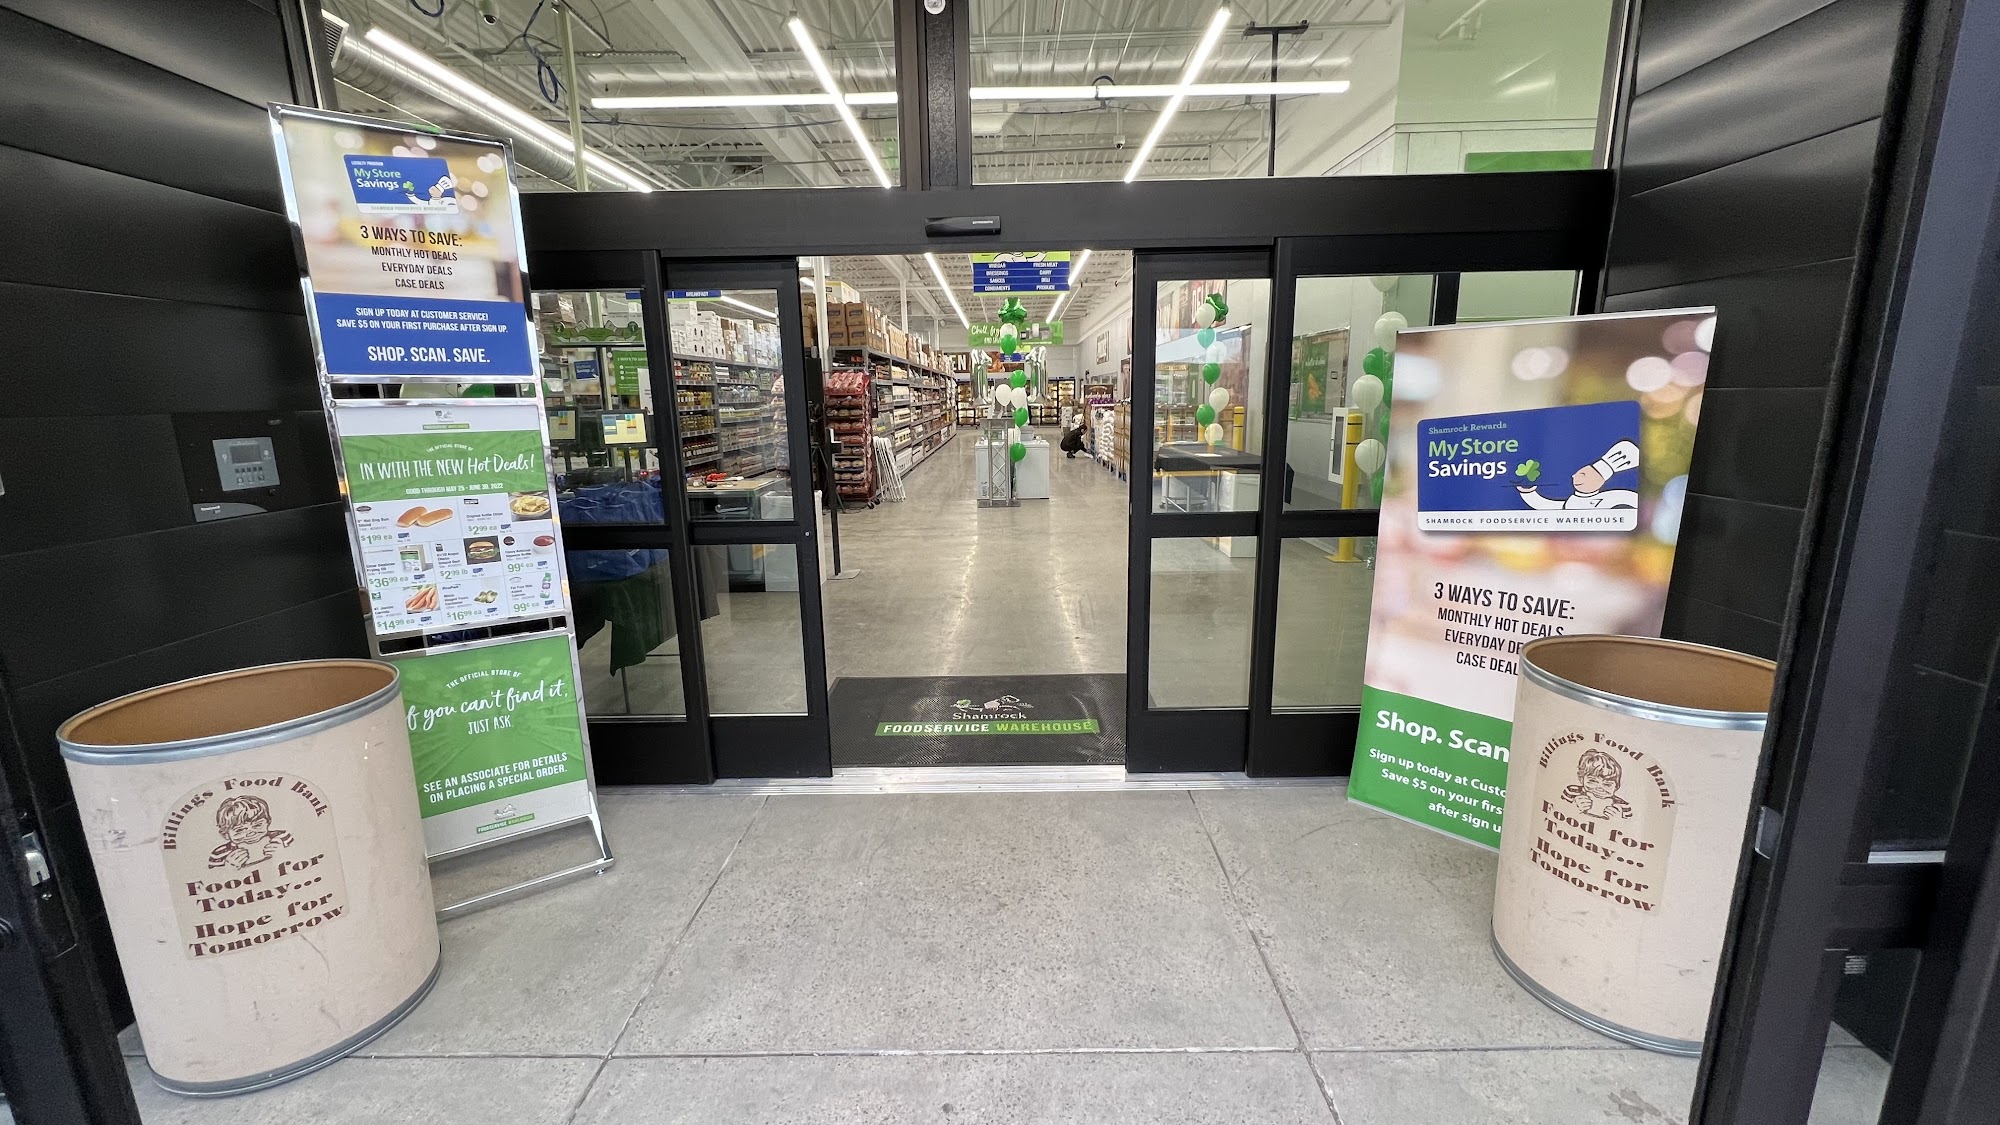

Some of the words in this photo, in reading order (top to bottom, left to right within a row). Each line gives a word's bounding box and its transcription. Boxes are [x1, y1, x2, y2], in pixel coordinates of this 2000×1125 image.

[354, 168, 371, 179] My
[372, 169, 401, 178] Store
[356, 179, 399, 190] Savings
[360, 226, 368, 238] 3
[372, 226, 407, 242] WAYS
[409, 230, 425, 244] TO
[429, 232, 462, 246] SAVE:
[371, 246, 411, 258] MONTHLY
[414, 249, 430, 259] HOT
[432, 251, 458, 261] DEALS
[382, 262, 425, 274] EVERYDAY
[427, 266, 453, 276] DEALS
[395, 278, 417, 288] CASE
[419, 280, 445, 290] DEALS
[336, 319, 356, 328] SAVE
[358, 320, 368, 328] $5
[370, 320, 380, 328] ON
[381, 321, 400, 330] YOUR
[402, 322, 421, 330] FIRST
[423, 322, 459, 331] PURCHASE
[460, 323, 481, 332] AFTER
[482, 324, 497, 332] SIGN
[356, 308, 373, 316] SIGN
[386, 309, 408, 318] TODAY
[411, 310, 419, 318] AT
[421, 311, 458, 320] CUSTOMER
[459, 312, 488, 320] SERVICE!
[367, 346, 408, 361] SHOP.
[410, 347, 450, 362] SCAN.
[453, 348, 490, 362] SAVE.
[1428, 424, 1468, 435] Shamrock
[1470, 421, 1507, 431] Rewards
[1428, 440, 1458, 460] My
[1461, 437, 1518, 455] Store
[360, 463, 374, 480] IN
[377, 461, 410, 479] WITH
[413, 460, 434, 477] THE
[436, 459, 464, 476] NEW
[468, 457, 490, 474] Hot
[494, 454, 534, 472] Deals!
[1428, 459, 1507, 480] Savings
[1434, 582, 1444, 599] 3
[1449, 583, 1492, 607] WAYS
[1498, 591, 1518, 611] TO
[1522, 595, 1575, 620] SAVE:
[1438, 607, 1492, 628] MONTHLY
[1495, 617, 1519, 633] HOT
[1445, 629, 1505, 651] EVERYDAY
[1456, 651, 1487, 668] CASE
[1490, 658, 1518, 676] DEAL
[446, 679, 460, 690] THE
[460, 671, 489, 683] OFFICIAL
[405, 704, 420, 730] f
[423, 706, 457, 731] you
[461, 689, 505, 714] can't
[506, 680, 544, 712] find
[952, 712, 1027, 720] Shamrock
[468, 718, 489, 735] JUST
[884, 723, 990, 733] FOODSERVICE
[996, 721, 1092, 732] WAREHOUSE
[1376, 710, 1442, 744] Shop.
[423, 782, 442, 793] SEE
[445, 778, 458, 787] AN
[461, 764, 511, 784] ASSOCIATE
[513, 760, 530, 772] FOR
[532, 752, 567, 768] DETAILS
[1369, 748, 1395, 763] Sign
[1398, 758, 1414, 770] up
[1417, 762, 1452, 782] today
[1454, 775, 1468, 786] at
[1471, 779, 1506, 798] Custo
[1539, 731, 1585, 769] Billings
[1594, 732, 1643, 761] Food
[1647, 764, 1676, 809] Bank
[430, 792, 443, 803] ON
[446, 782, 486, 800] PLACING
[489, 780, 495, 789] A
[497, 772, 534, 787] SPECIAL
[536, 764, 568, 778] ORDER.
[1382, 768, 1409, 784] Save
[1412, 777, 1427, 790] $5
[1430, 785, 1445, 796] on
[1448, 791, 1479, 807] your
[1482, 800, 1504, 815] firs
[163, 788, 214, 850] Billings
[224, 776, 283, 791] Food
[291, 781, 328, 818] Bank
[1428, 802, 1459, 818] after
[1462, 813, 1489, 828] sign
[1493, 824, 1501, 833] u
[1542, 799, 1595, 835] Food
[1608, 828, 1655, 852] for
[1544, 817, 1645, 868] Today...
[185, 869, 261, 897] Food
[278, 853, 325, 878] for
[1537, 836, 1591, 874] Hope
[1604, 869, 1649, 893] for
[1529, 848, 1656, 912] Tomorrow
[196, 876, 322, 913] Today...
[194, 913, 273, 939] Hope
[287, 891, 333, 918] for
[188, 904, 345, 958] Tomorrow
